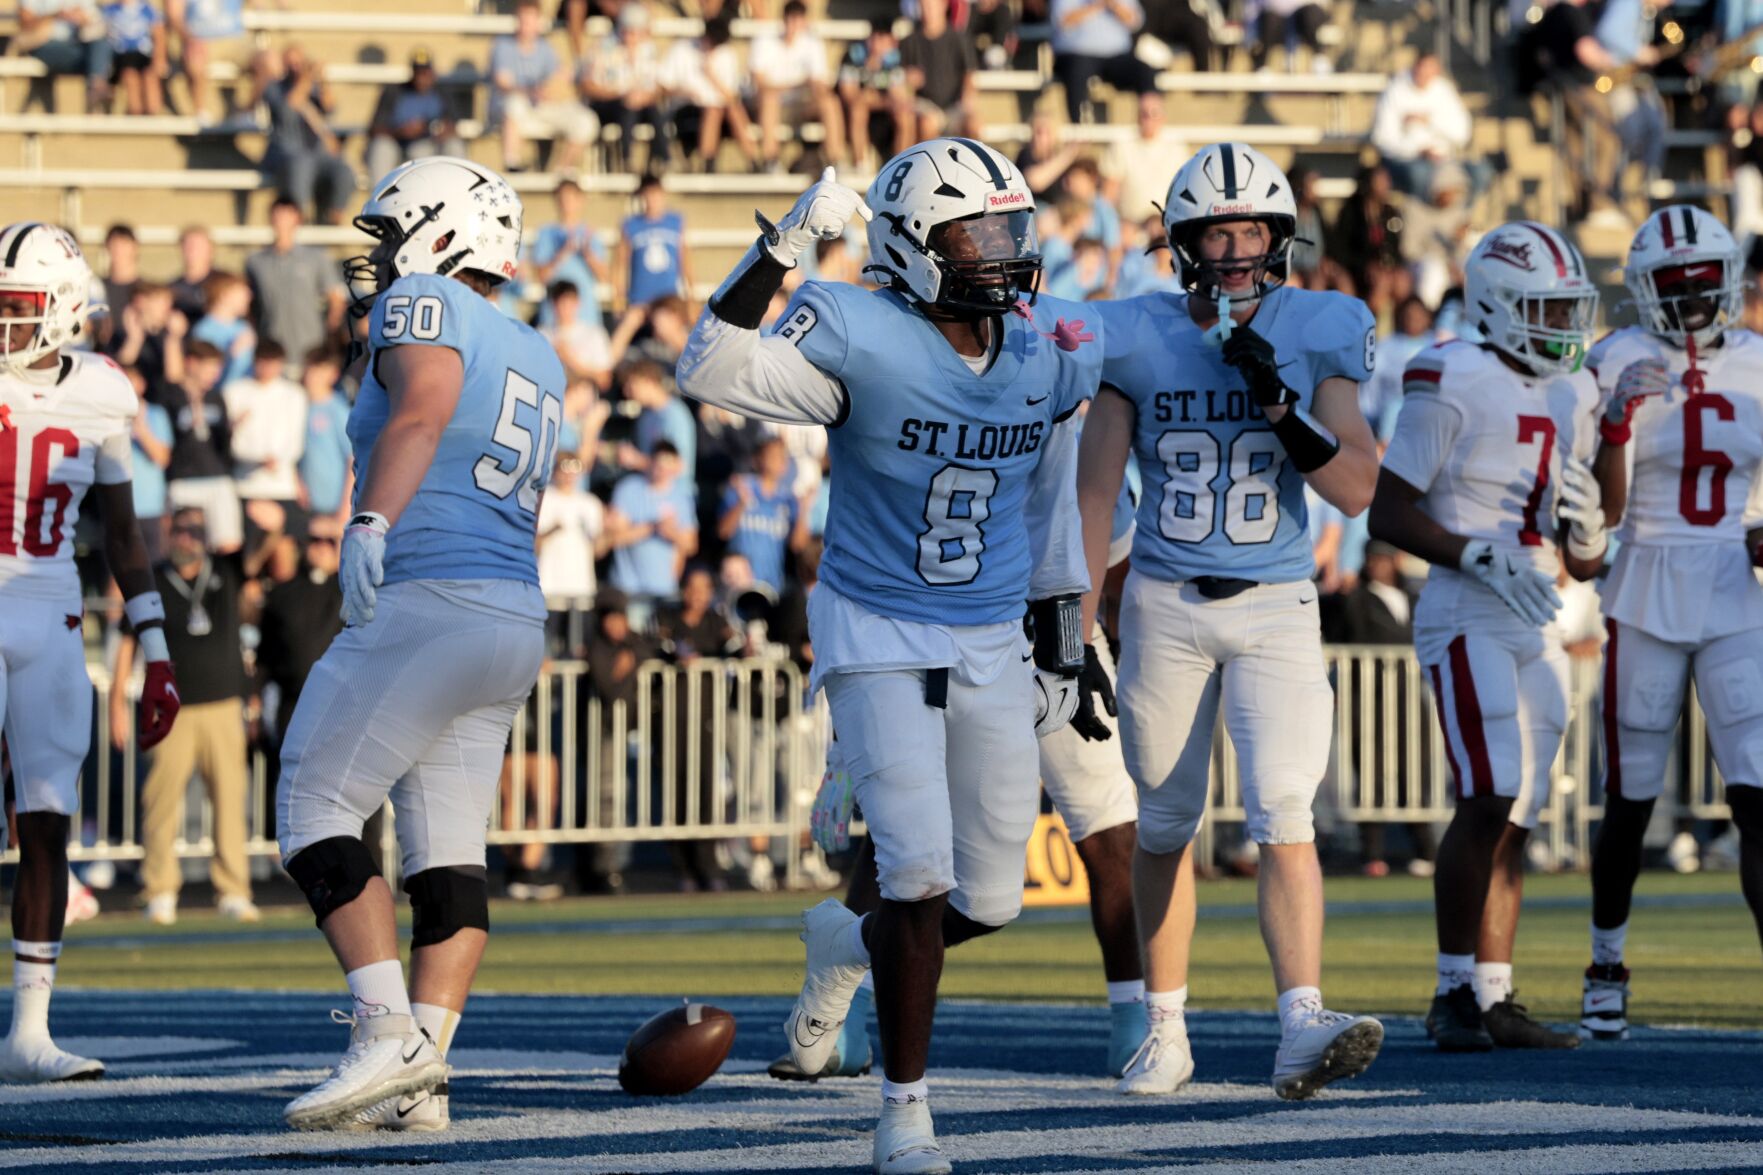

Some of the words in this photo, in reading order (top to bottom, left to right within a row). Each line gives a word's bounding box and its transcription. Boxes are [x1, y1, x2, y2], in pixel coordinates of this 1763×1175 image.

[884, 161, 914, 203] 8
[990, 193, 1026, 206] Riddell
[381, 296, 445, 341] 50
[774, 302, 818, 346] 8
[471, 366, 561, 516] 50
[897, 418, 949, 457] ST.
[954, 421, 1044, 460] LOUIS
[1154, 389, 1197, 422] ST.
[1206, 390, 1265, 422] LOU
[0, 427, 79, 558] 16
[1155, 429, 1290, 546] 88
[1516, 414, 1557, 546] 7
[1679, 393, 1736, 527] 6
[914, 462, 1000, 587] 8
